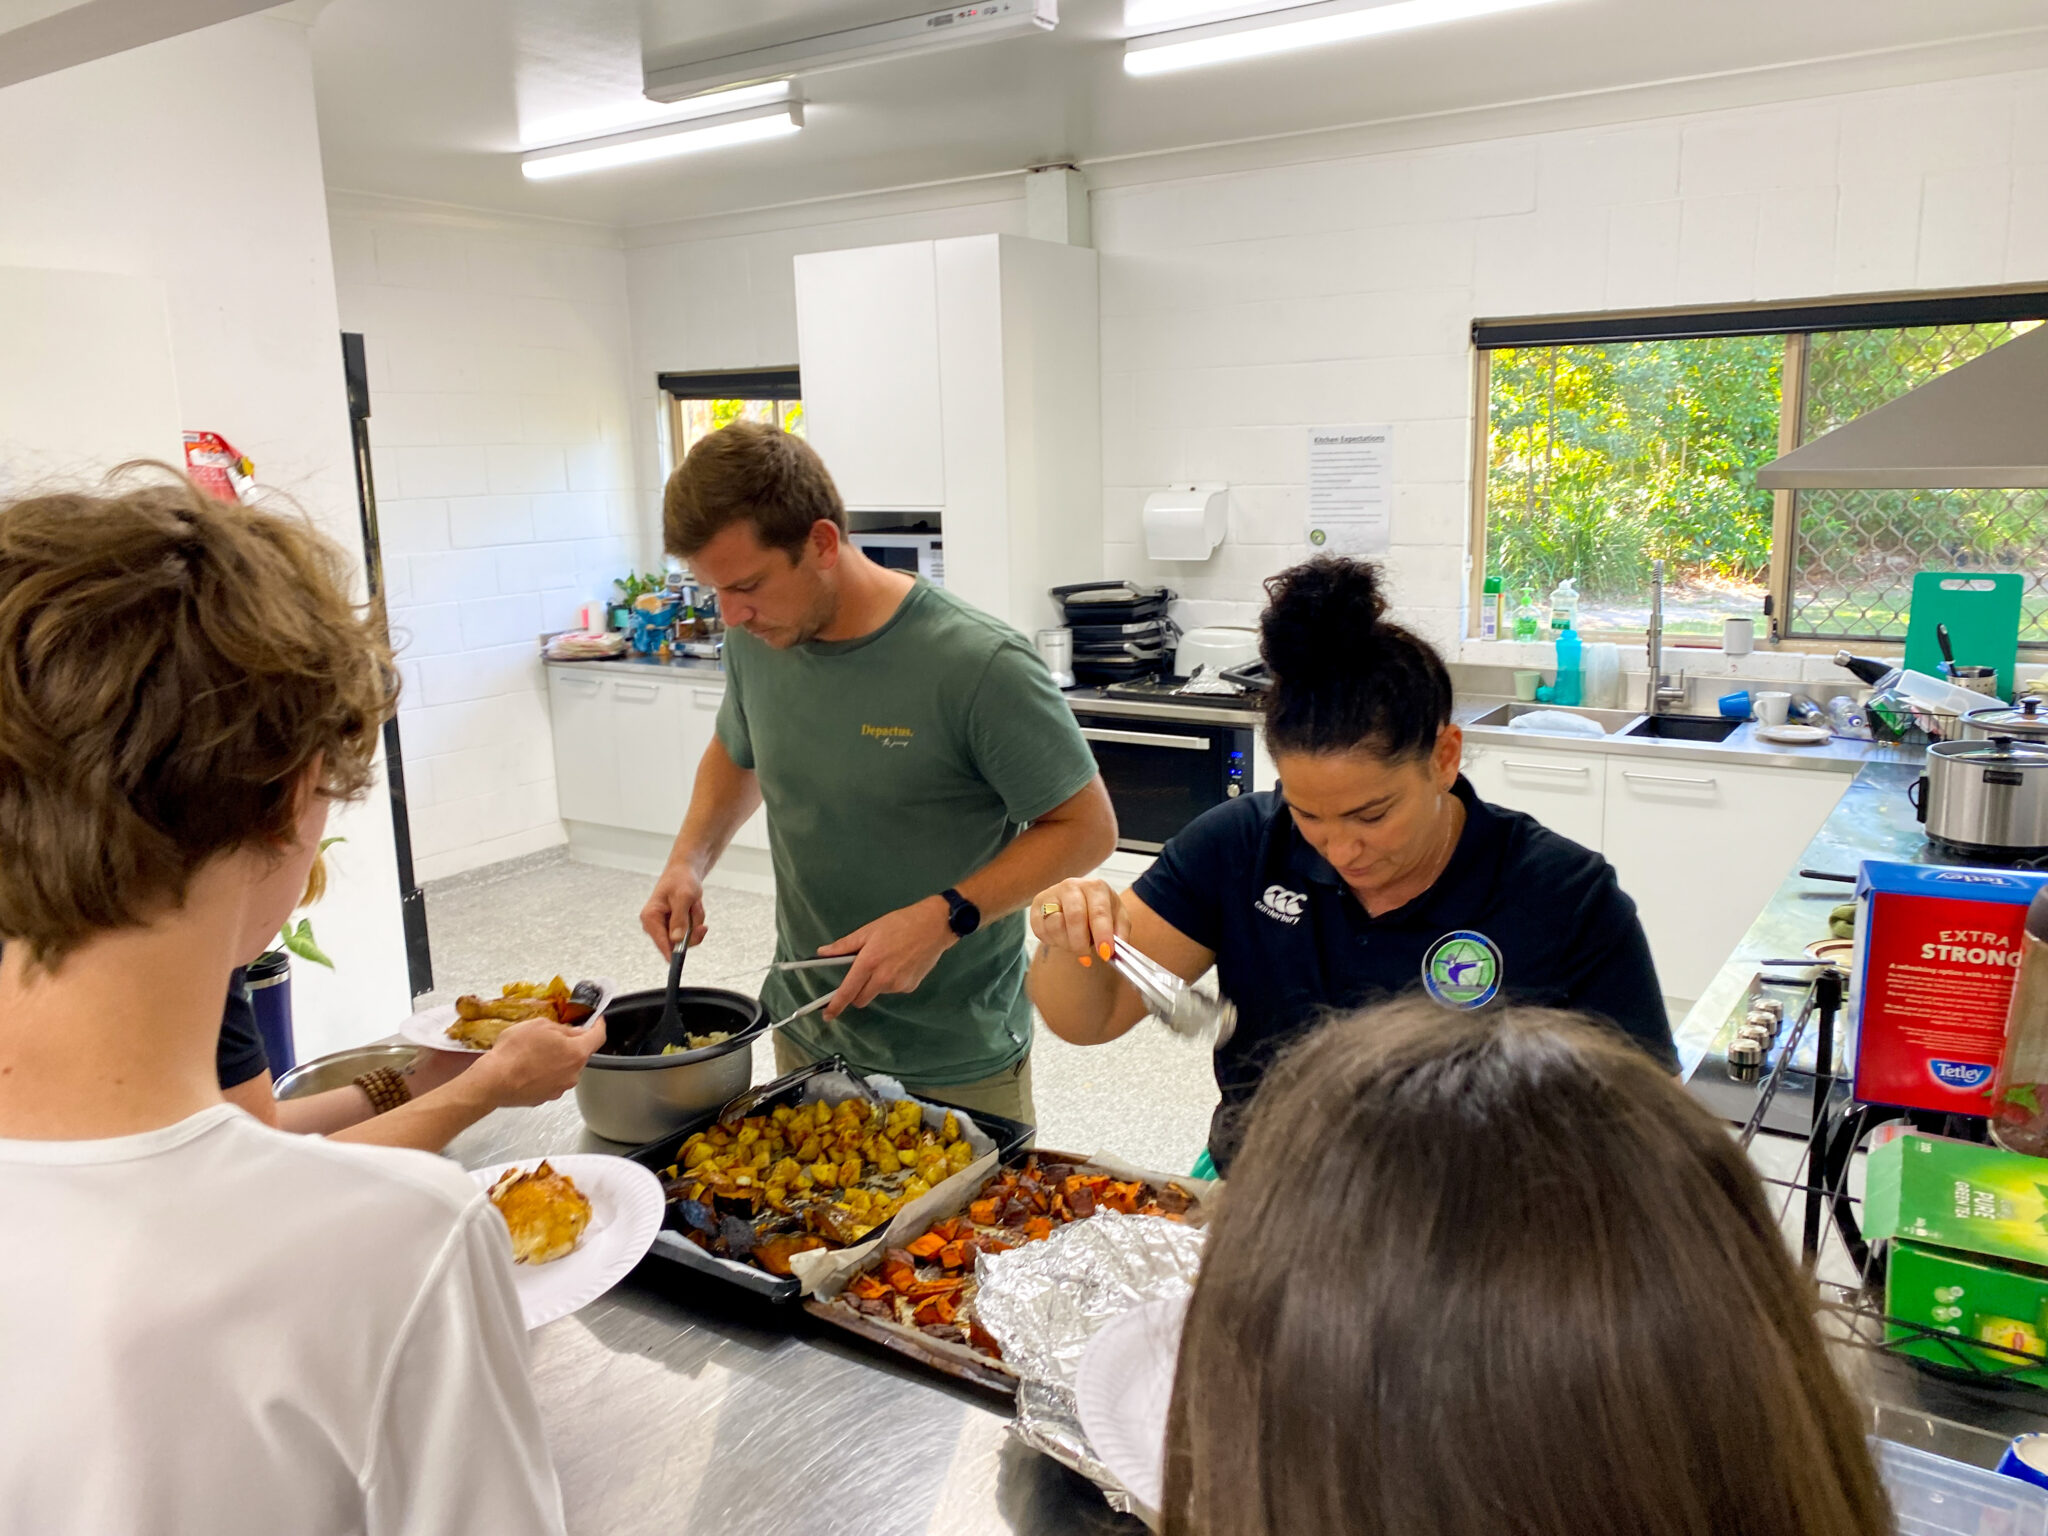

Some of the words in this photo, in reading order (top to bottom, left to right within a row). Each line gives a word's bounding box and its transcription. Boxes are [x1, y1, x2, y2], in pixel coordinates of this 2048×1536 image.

[1314, 436, 1339, 444] Kitchen
[1341, 435, 1385, 443] Expectations
[1936, 872, 2011, 886] Tetley
[1254, 900, 1301, 925] canterbury
[1939, 930, 2009, 948] EXTRA
[1920, 943, 2021, 967] STRONG
[1937, 1063, 1983, 1083] Tetley
[1955, 1181, 1970, 1205] GREEN
[1955, 1206, 1970, 1219] TEA
[1973, 1191, 1995, 1219] PURE
